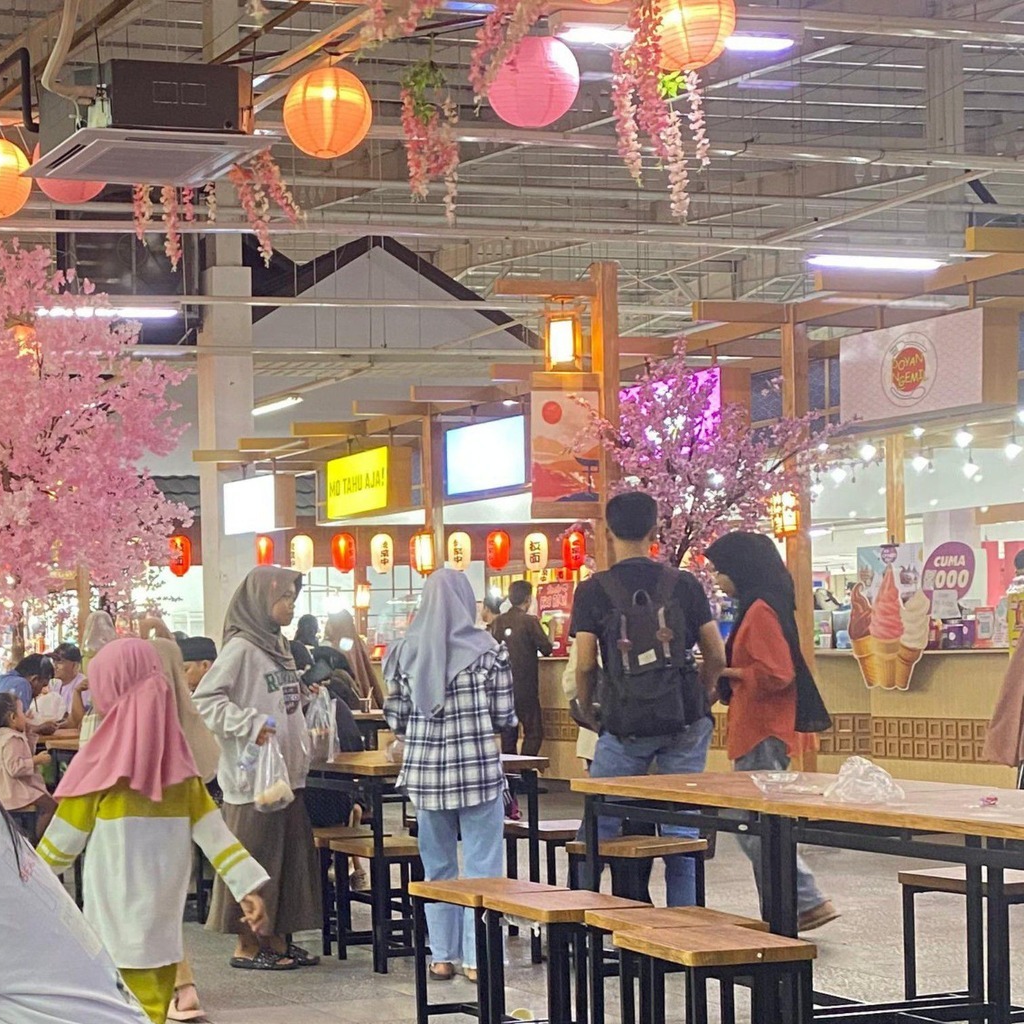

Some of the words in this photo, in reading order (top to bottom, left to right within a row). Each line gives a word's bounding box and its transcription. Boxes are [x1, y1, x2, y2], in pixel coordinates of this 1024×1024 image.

[329, 480, 340, 497] MO
[343, 474, 363, 495] TAHU
[365, 467, 385, 489] AJA!
[933, 554, 966, 567] CUMA
